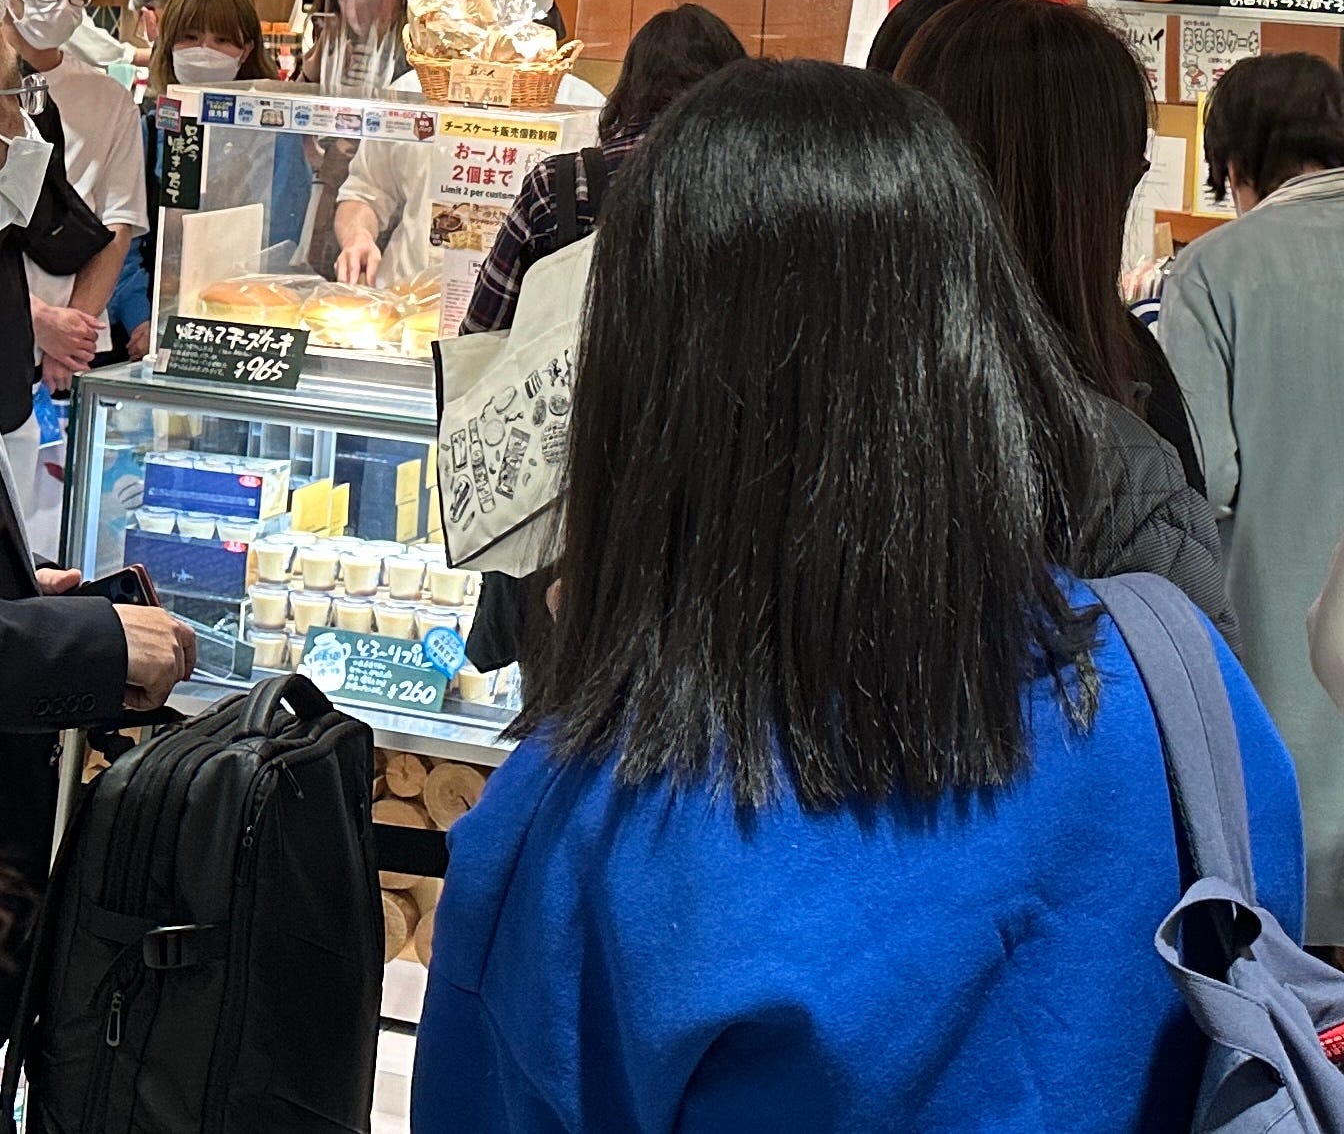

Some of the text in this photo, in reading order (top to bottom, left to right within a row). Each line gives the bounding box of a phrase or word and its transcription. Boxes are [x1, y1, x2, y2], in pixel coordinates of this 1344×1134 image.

[1183, 26, 1259, 56] まるまるケーキ
[444, 120, 558, 142] チーズケーキ販売個数制限
[454, 142, 518, 166] お一人様
[452, 164, 514, 187] 2個まで
[440, 184, 520, 201] Limit 2 per custom
[175, 321, 295, 357] 焼きたてチーズケーキ
